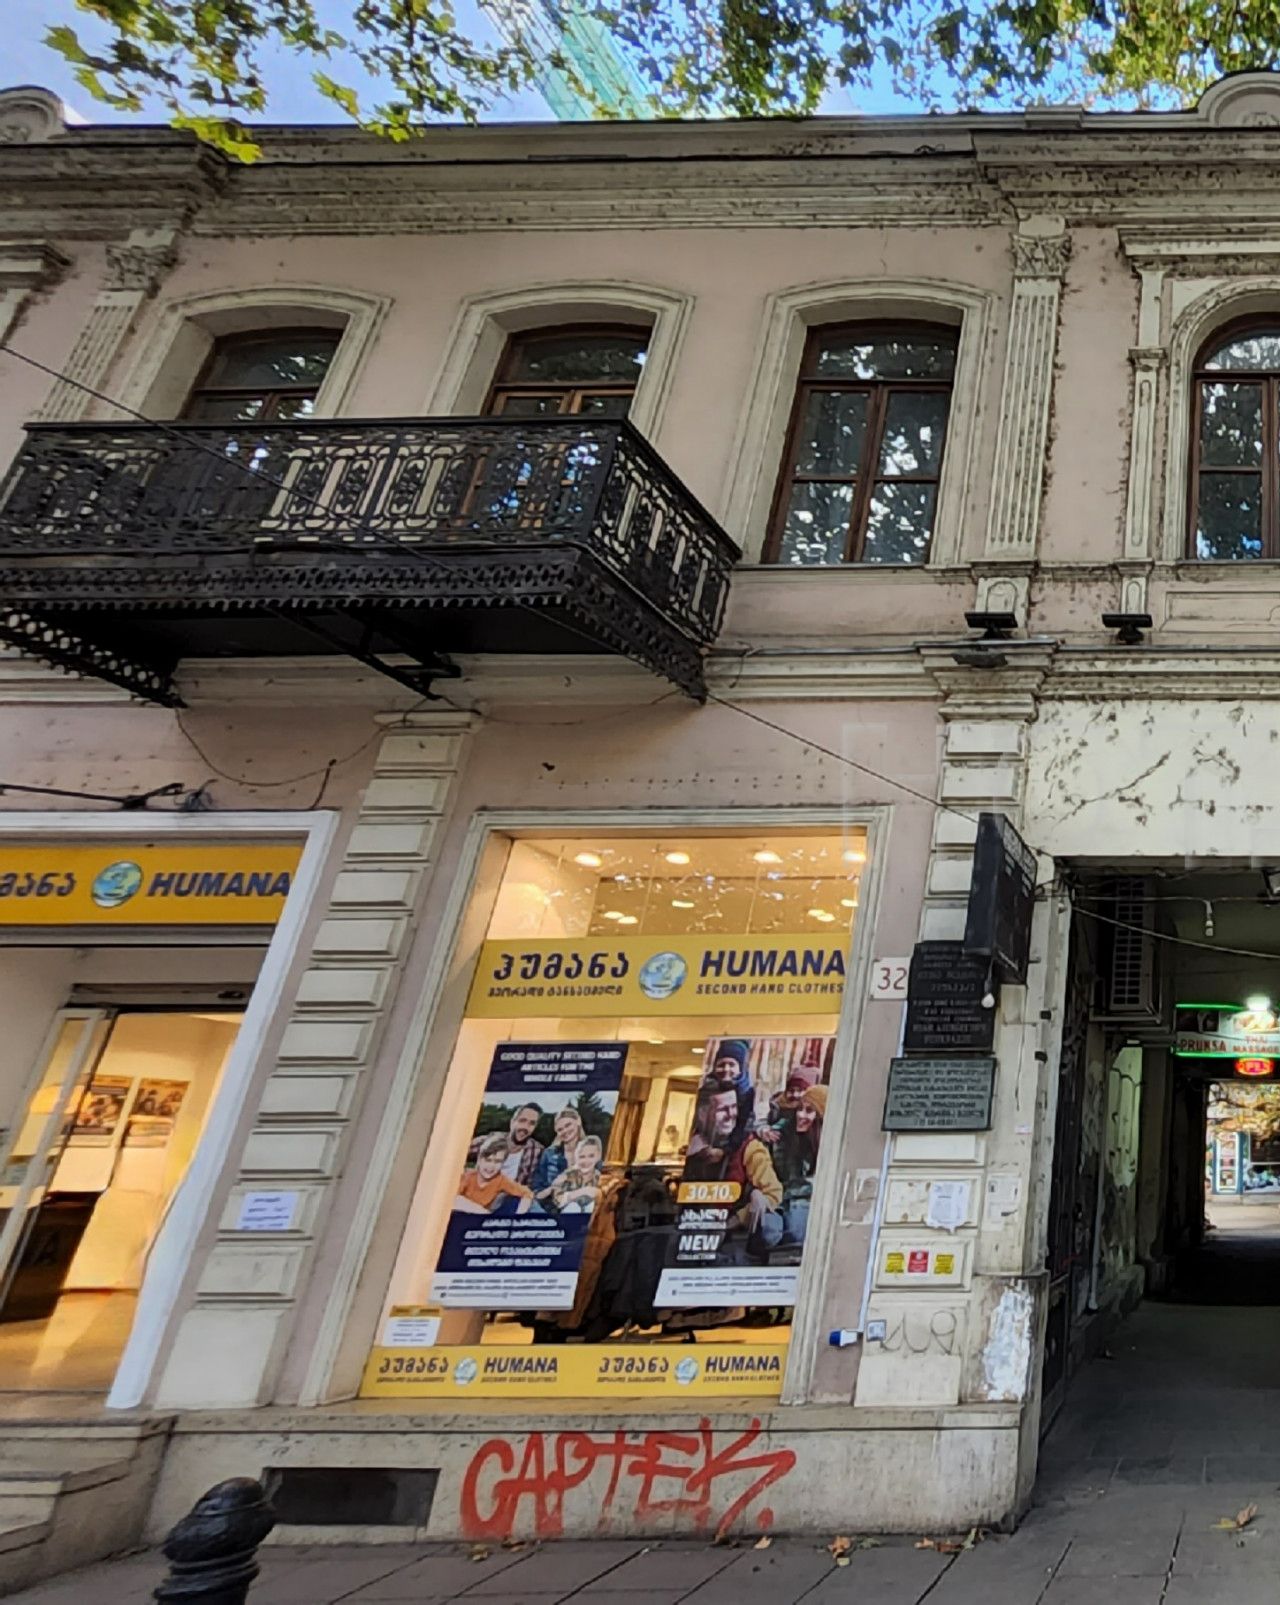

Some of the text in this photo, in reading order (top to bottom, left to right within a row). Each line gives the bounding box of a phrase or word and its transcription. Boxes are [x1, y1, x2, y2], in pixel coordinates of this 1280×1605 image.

[146, 871, 290, 897] HUMANA
[699, 949, 846, 978] HUMANA
[877, 967, 908, 991] 32
[695, 982, 845, 995] SECOND HAND CLOTHES
[679, 1235, 720, 1250] NEW
[483, 1356, 558, 1374] HUMANA
[705, 1355, 781, 1373] HUMANA
